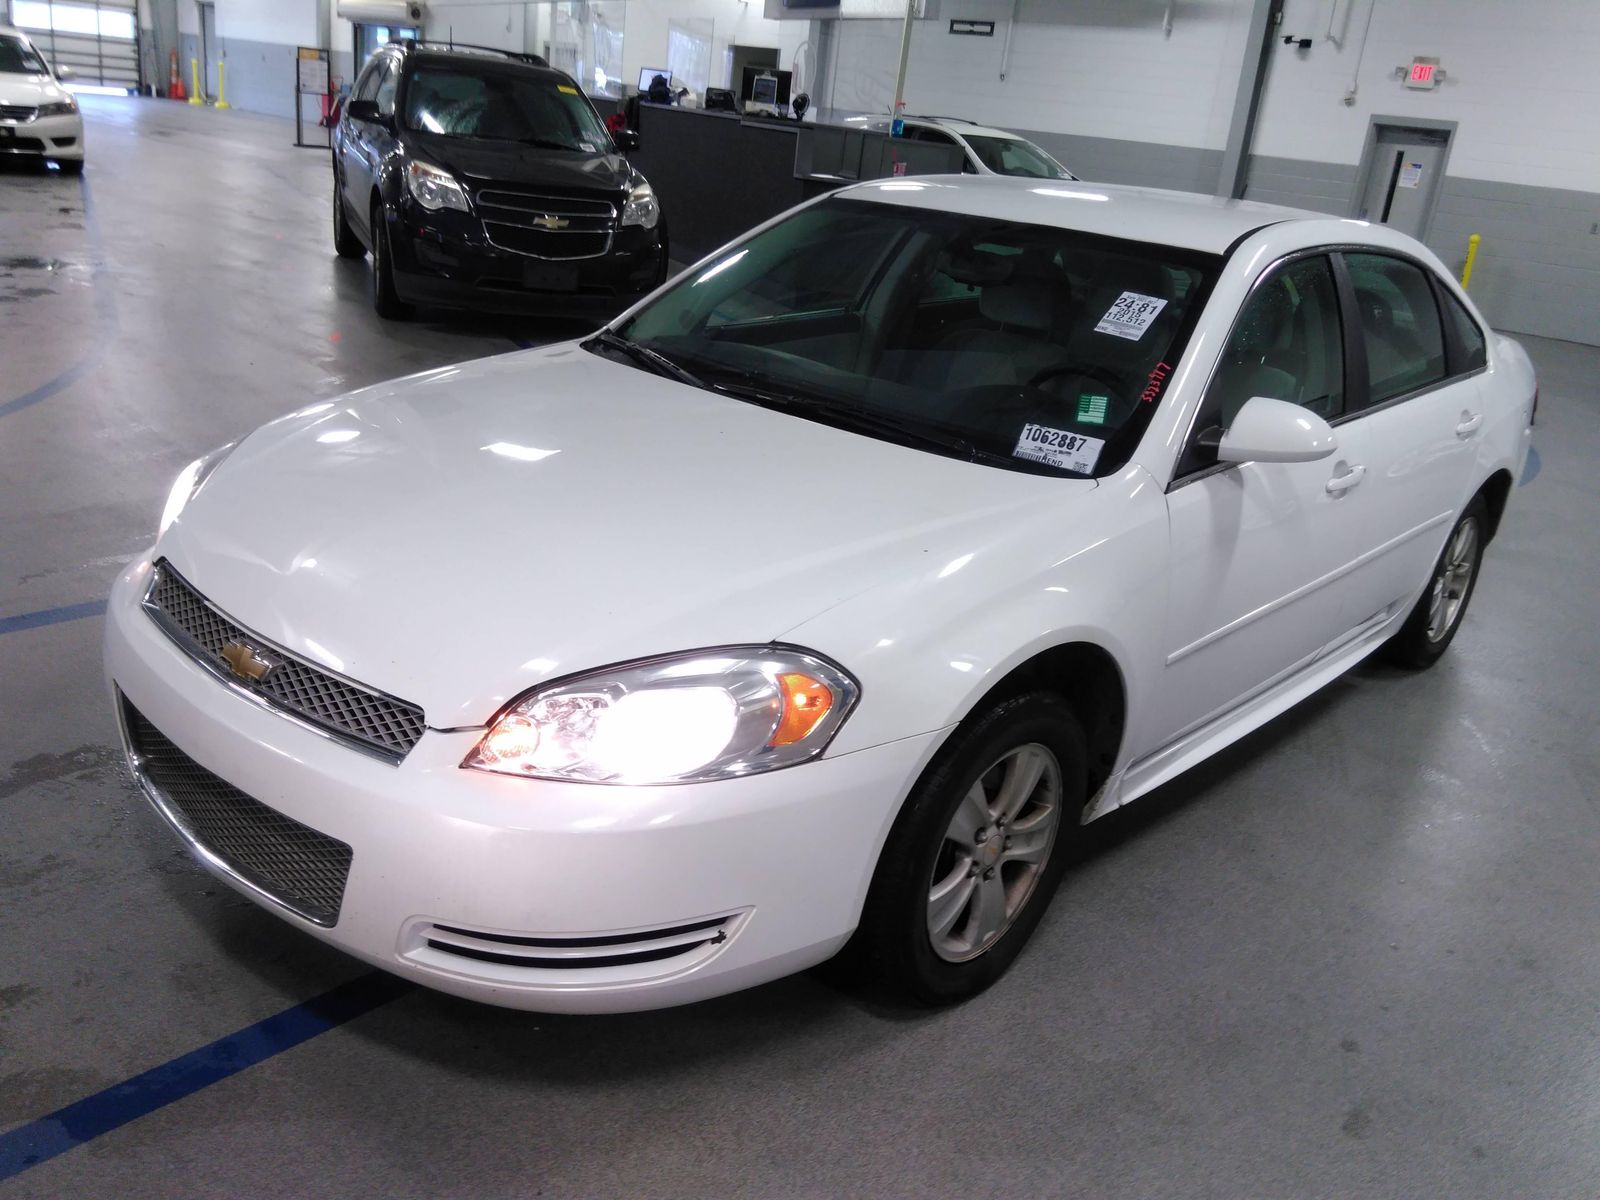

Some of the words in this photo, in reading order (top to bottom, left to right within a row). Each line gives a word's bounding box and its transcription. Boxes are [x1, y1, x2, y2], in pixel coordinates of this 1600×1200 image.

[1411, 64, 1433, 80] EXIT
[1118, 308, 1141, 318] 2015
[1025, 427, 1087, 452] 1062887
